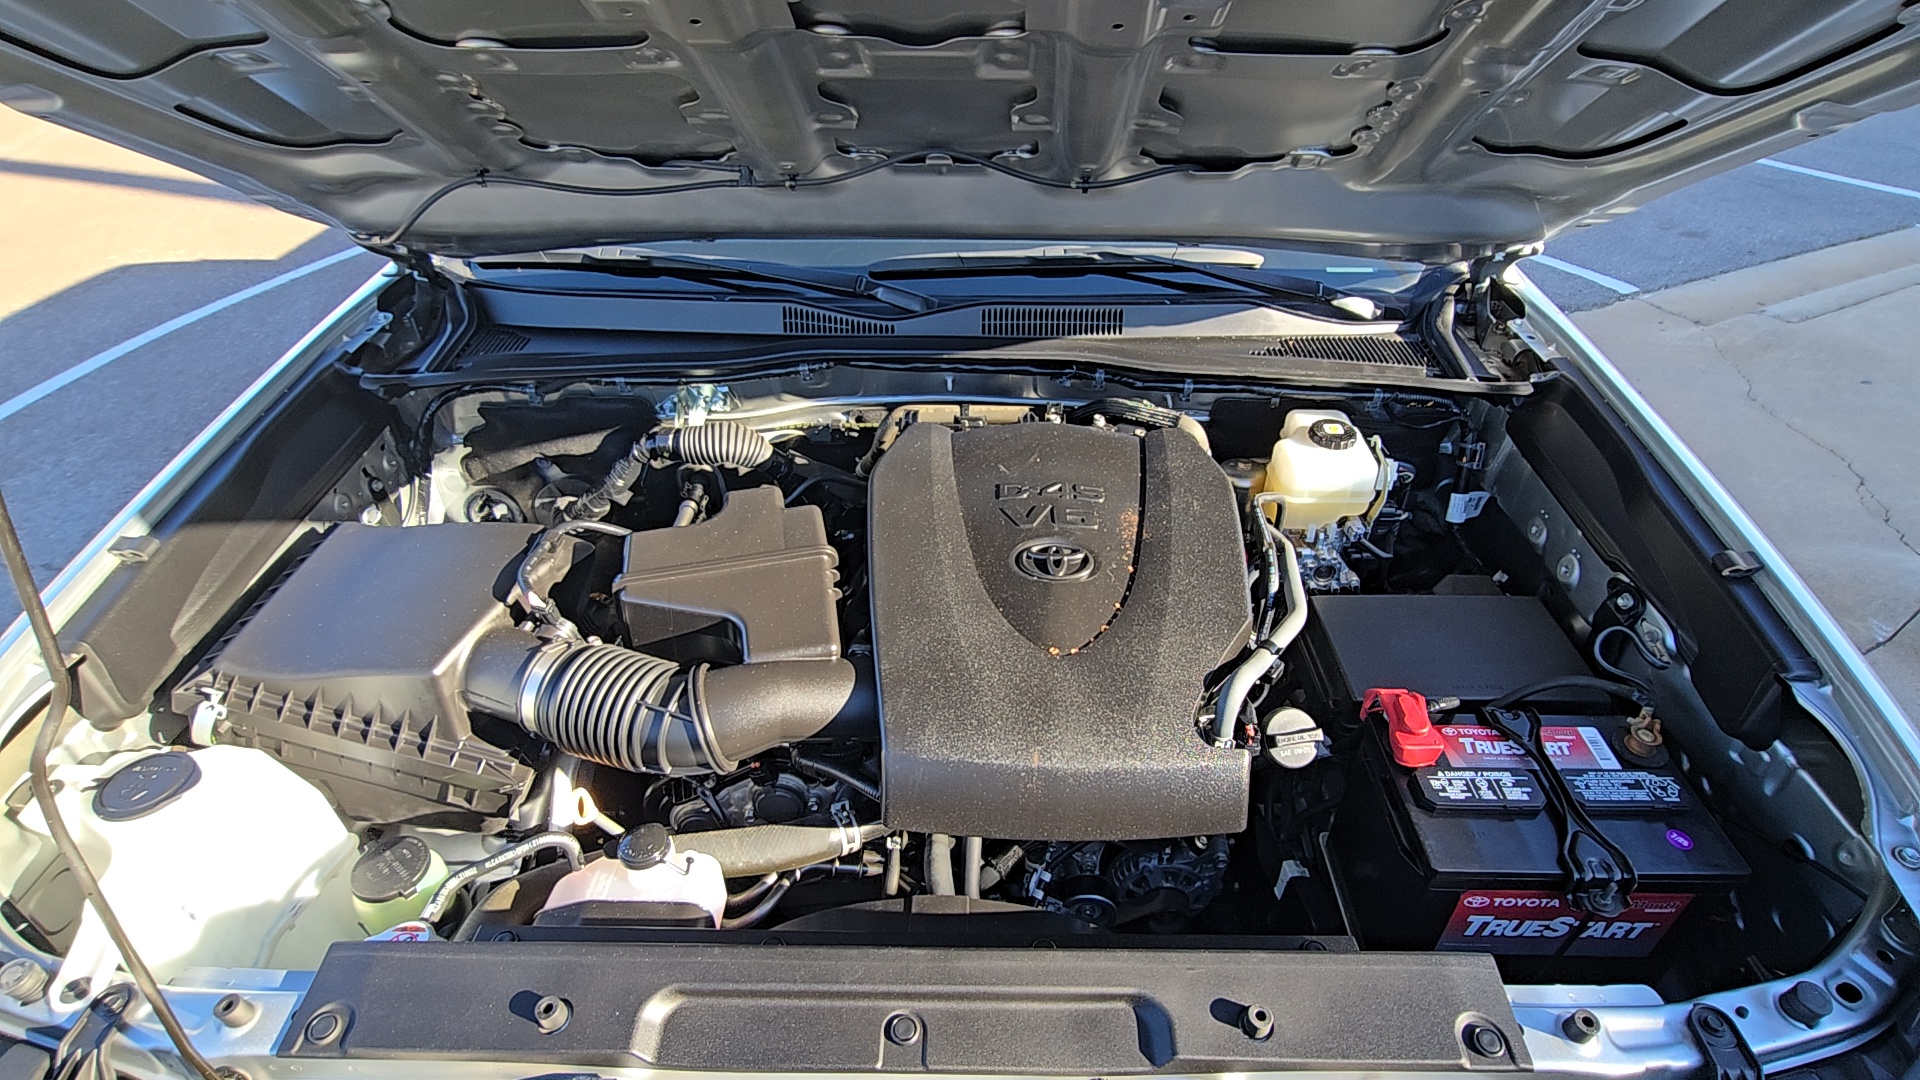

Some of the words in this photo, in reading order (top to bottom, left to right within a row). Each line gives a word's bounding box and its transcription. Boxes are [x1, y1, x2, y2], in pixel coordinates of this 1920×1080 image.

[998, 504, 1102, 530] V6
[1457, 727, 1501, 736] TOYOTA
[1493, 898, 1560, 908] TOYOTA
